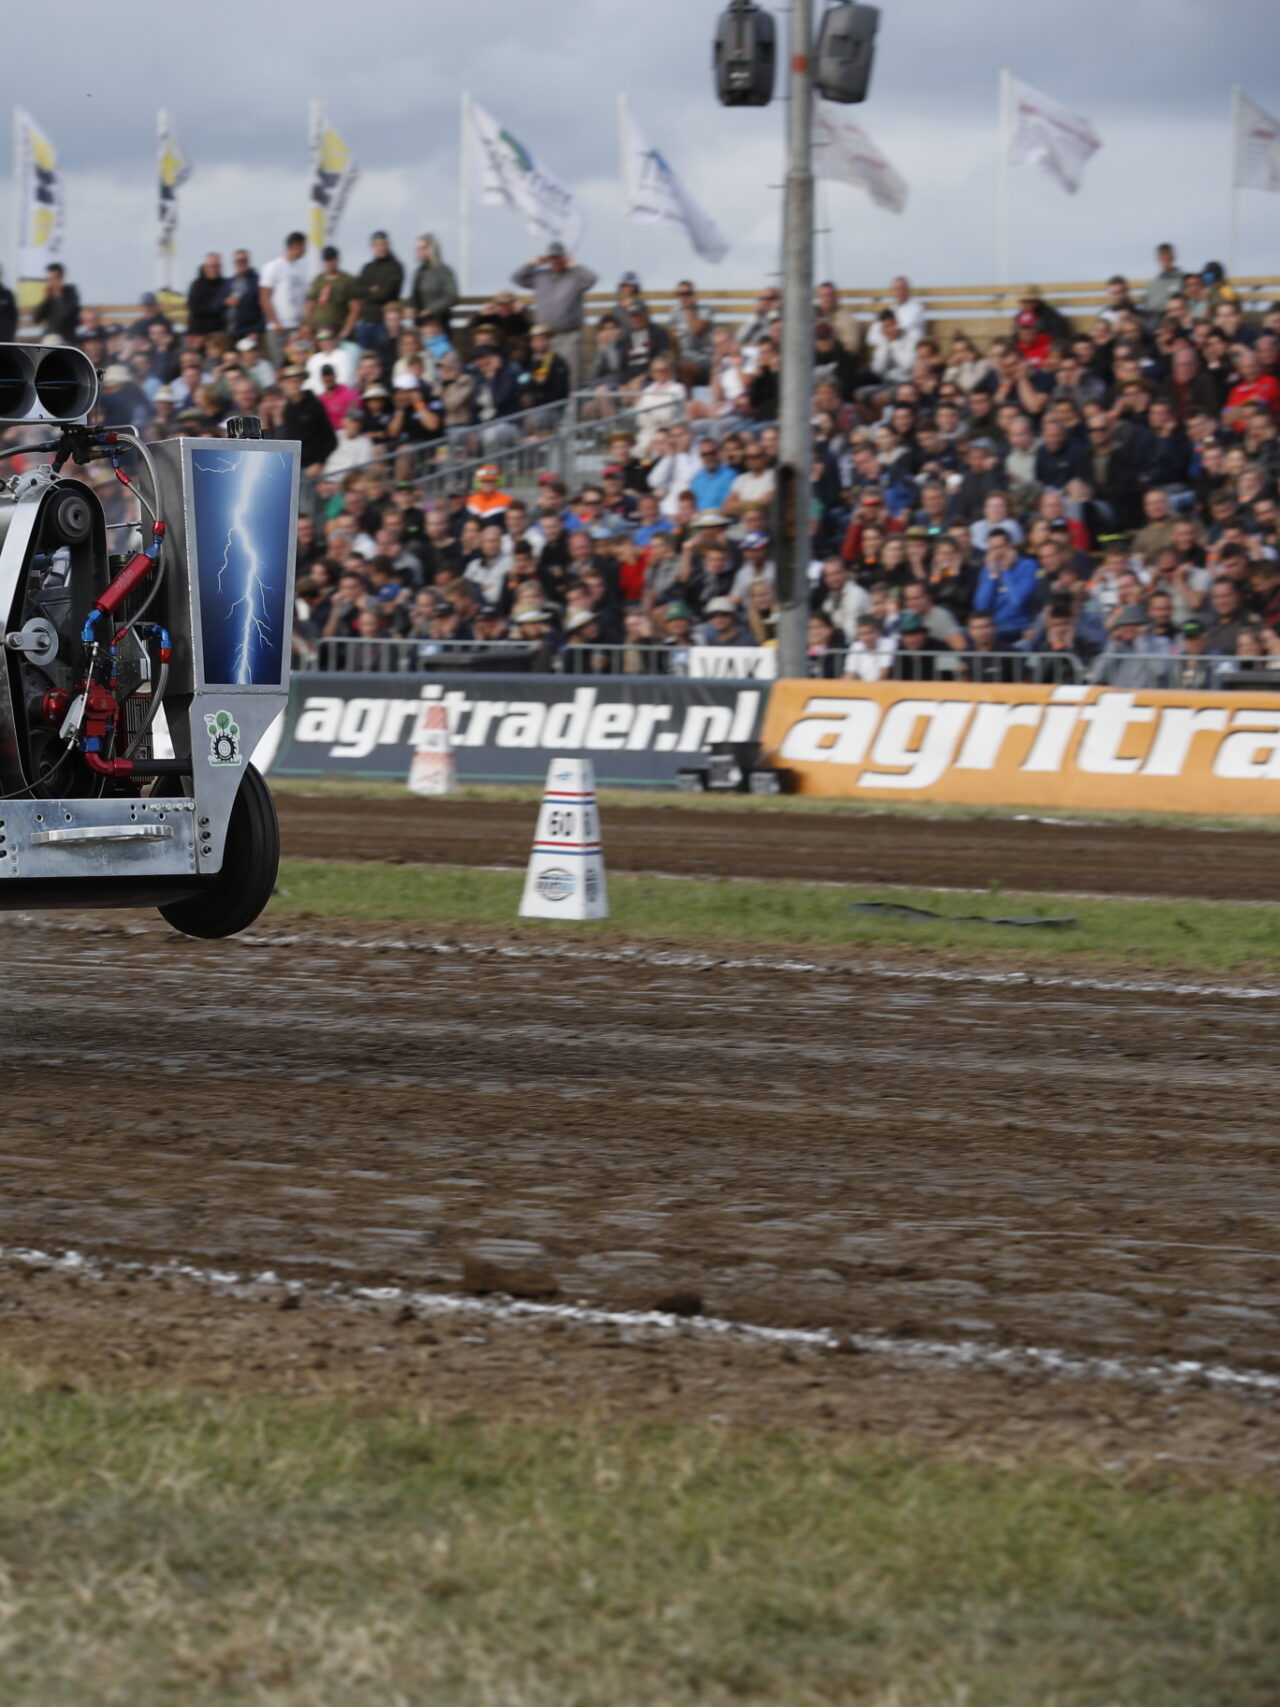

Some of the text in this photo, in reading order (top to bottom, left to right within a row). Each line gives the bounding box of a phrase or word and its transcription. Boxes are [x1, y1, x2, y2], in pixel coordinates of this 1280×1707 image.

[295, 684, 761, 758] agritrader.nl
[778, 684, 1280, 789] agritra
[548, 811, 576, 836] 60
